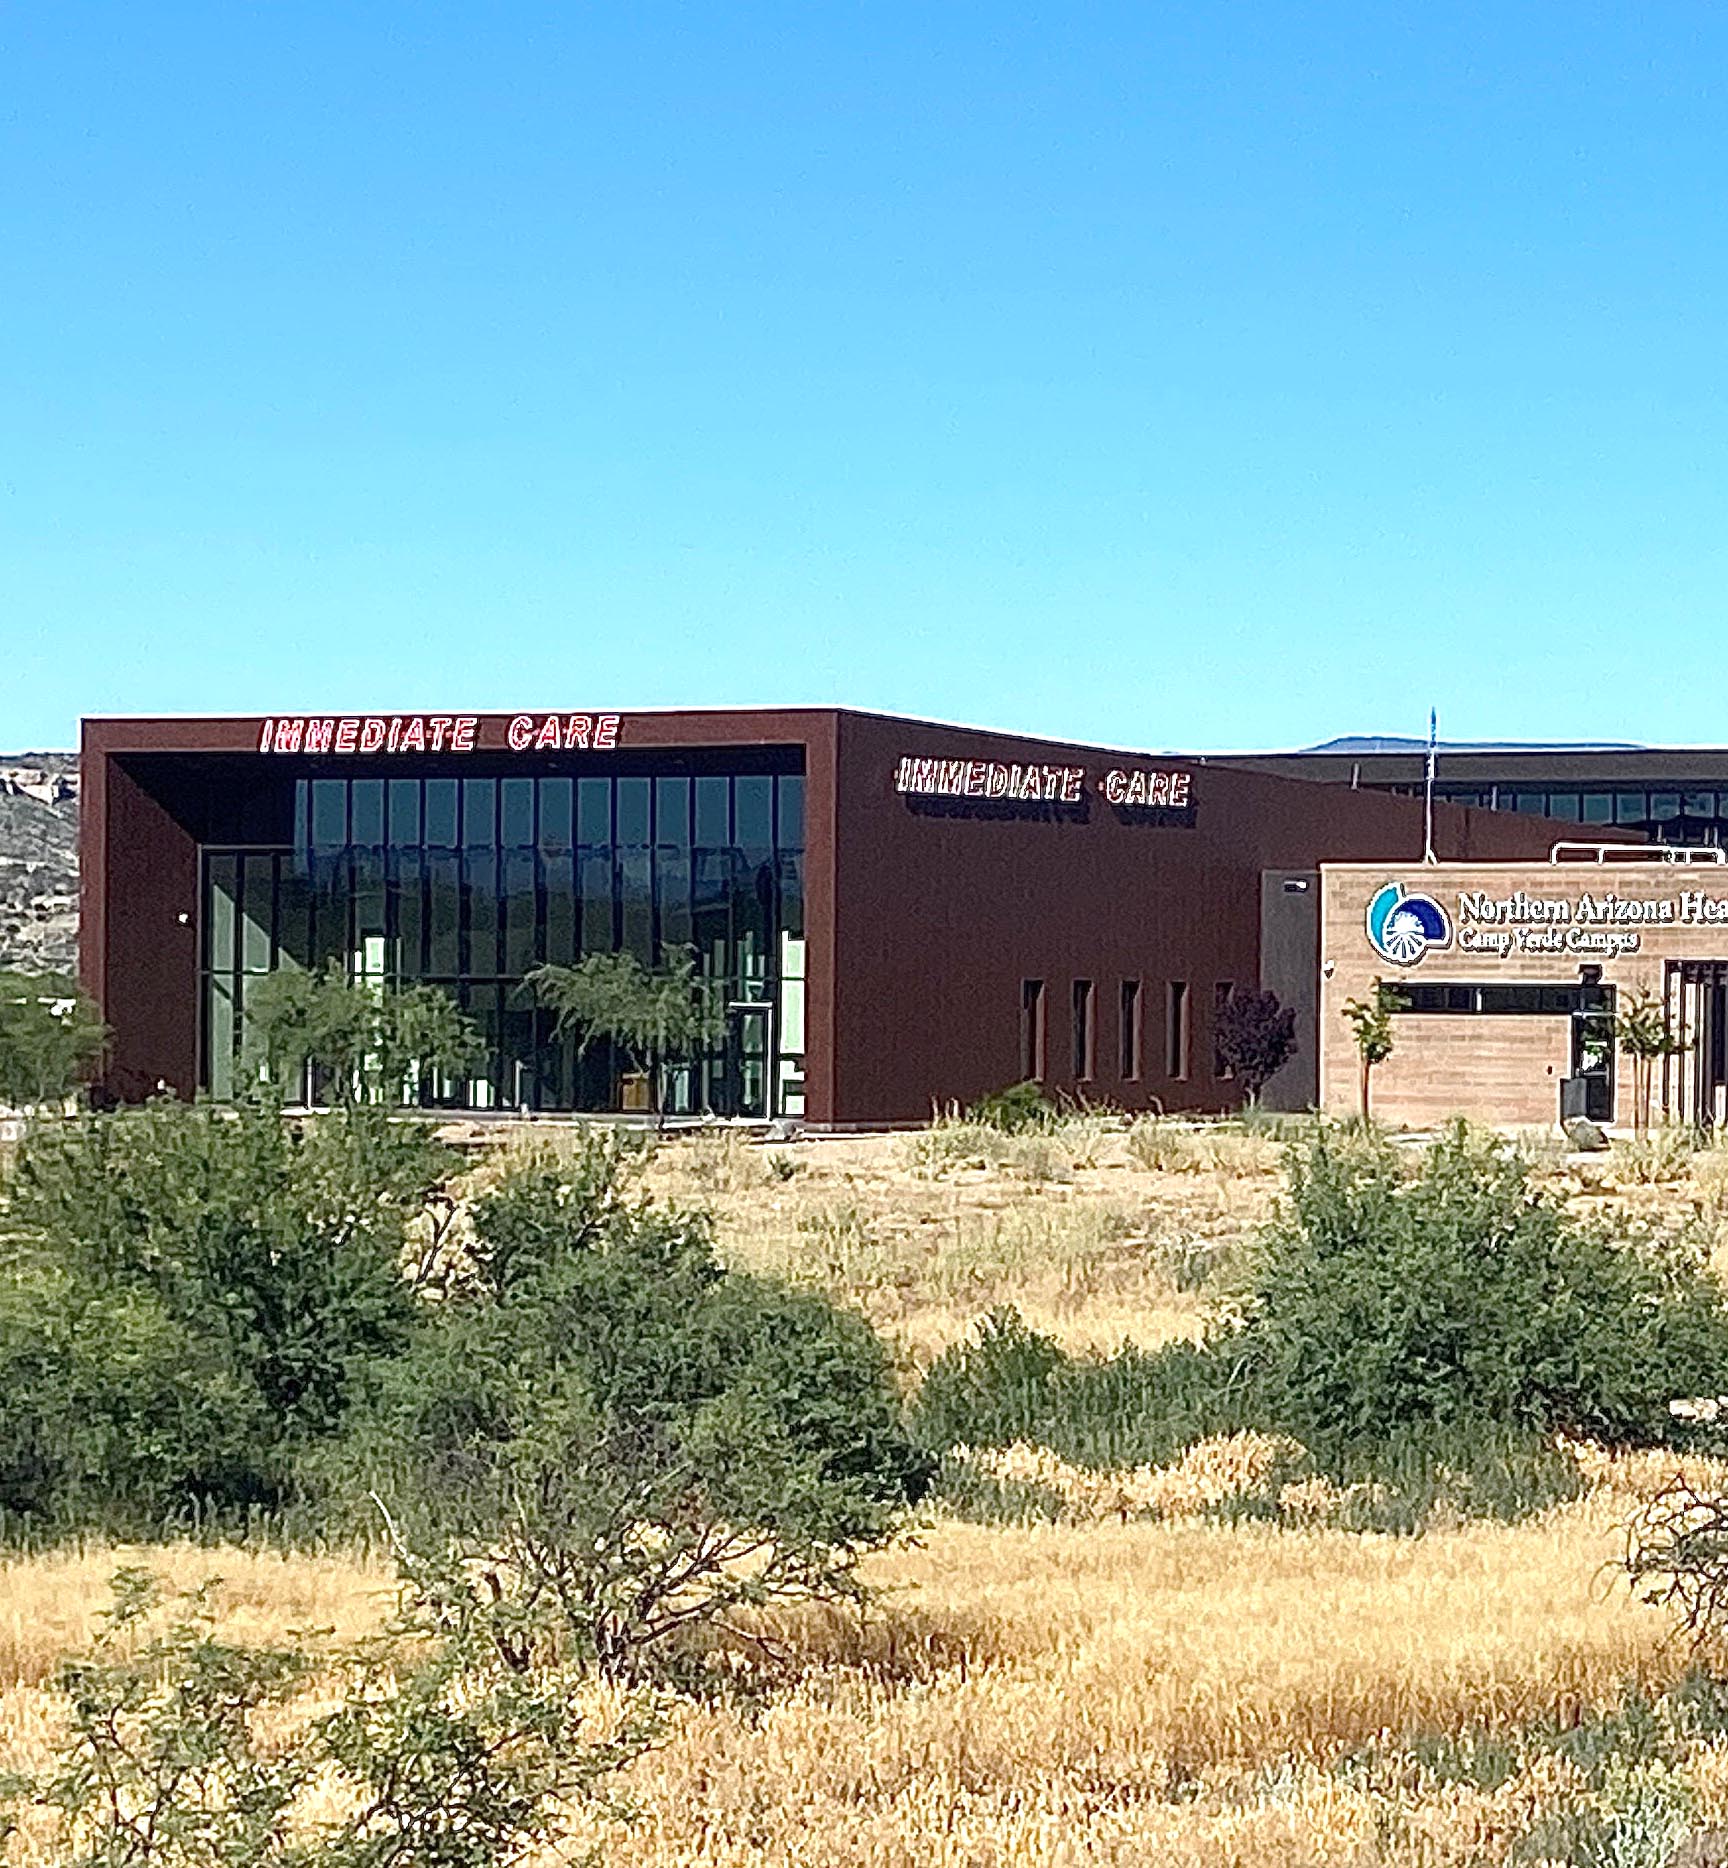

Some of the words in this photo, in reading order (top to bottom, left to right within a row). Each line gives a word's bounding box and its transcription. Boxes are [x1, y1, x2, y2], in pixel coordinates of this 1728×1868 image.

[260, 716, 478, 753] IMMEDIATE
[507, 714, 621, 751] CARE
[896, 757, 1085, 801] IMMEDIATE
[1105, 769, 1191, 807] CARE
[1458, 891, 1570, 921] Northern
[1576, 893, 1674, 921] Arizona
[1458, 927, 1512, 956] Camp
[1513, 927, 1565, 950] Verde
[1566, 927, 1639, 957] Campus
